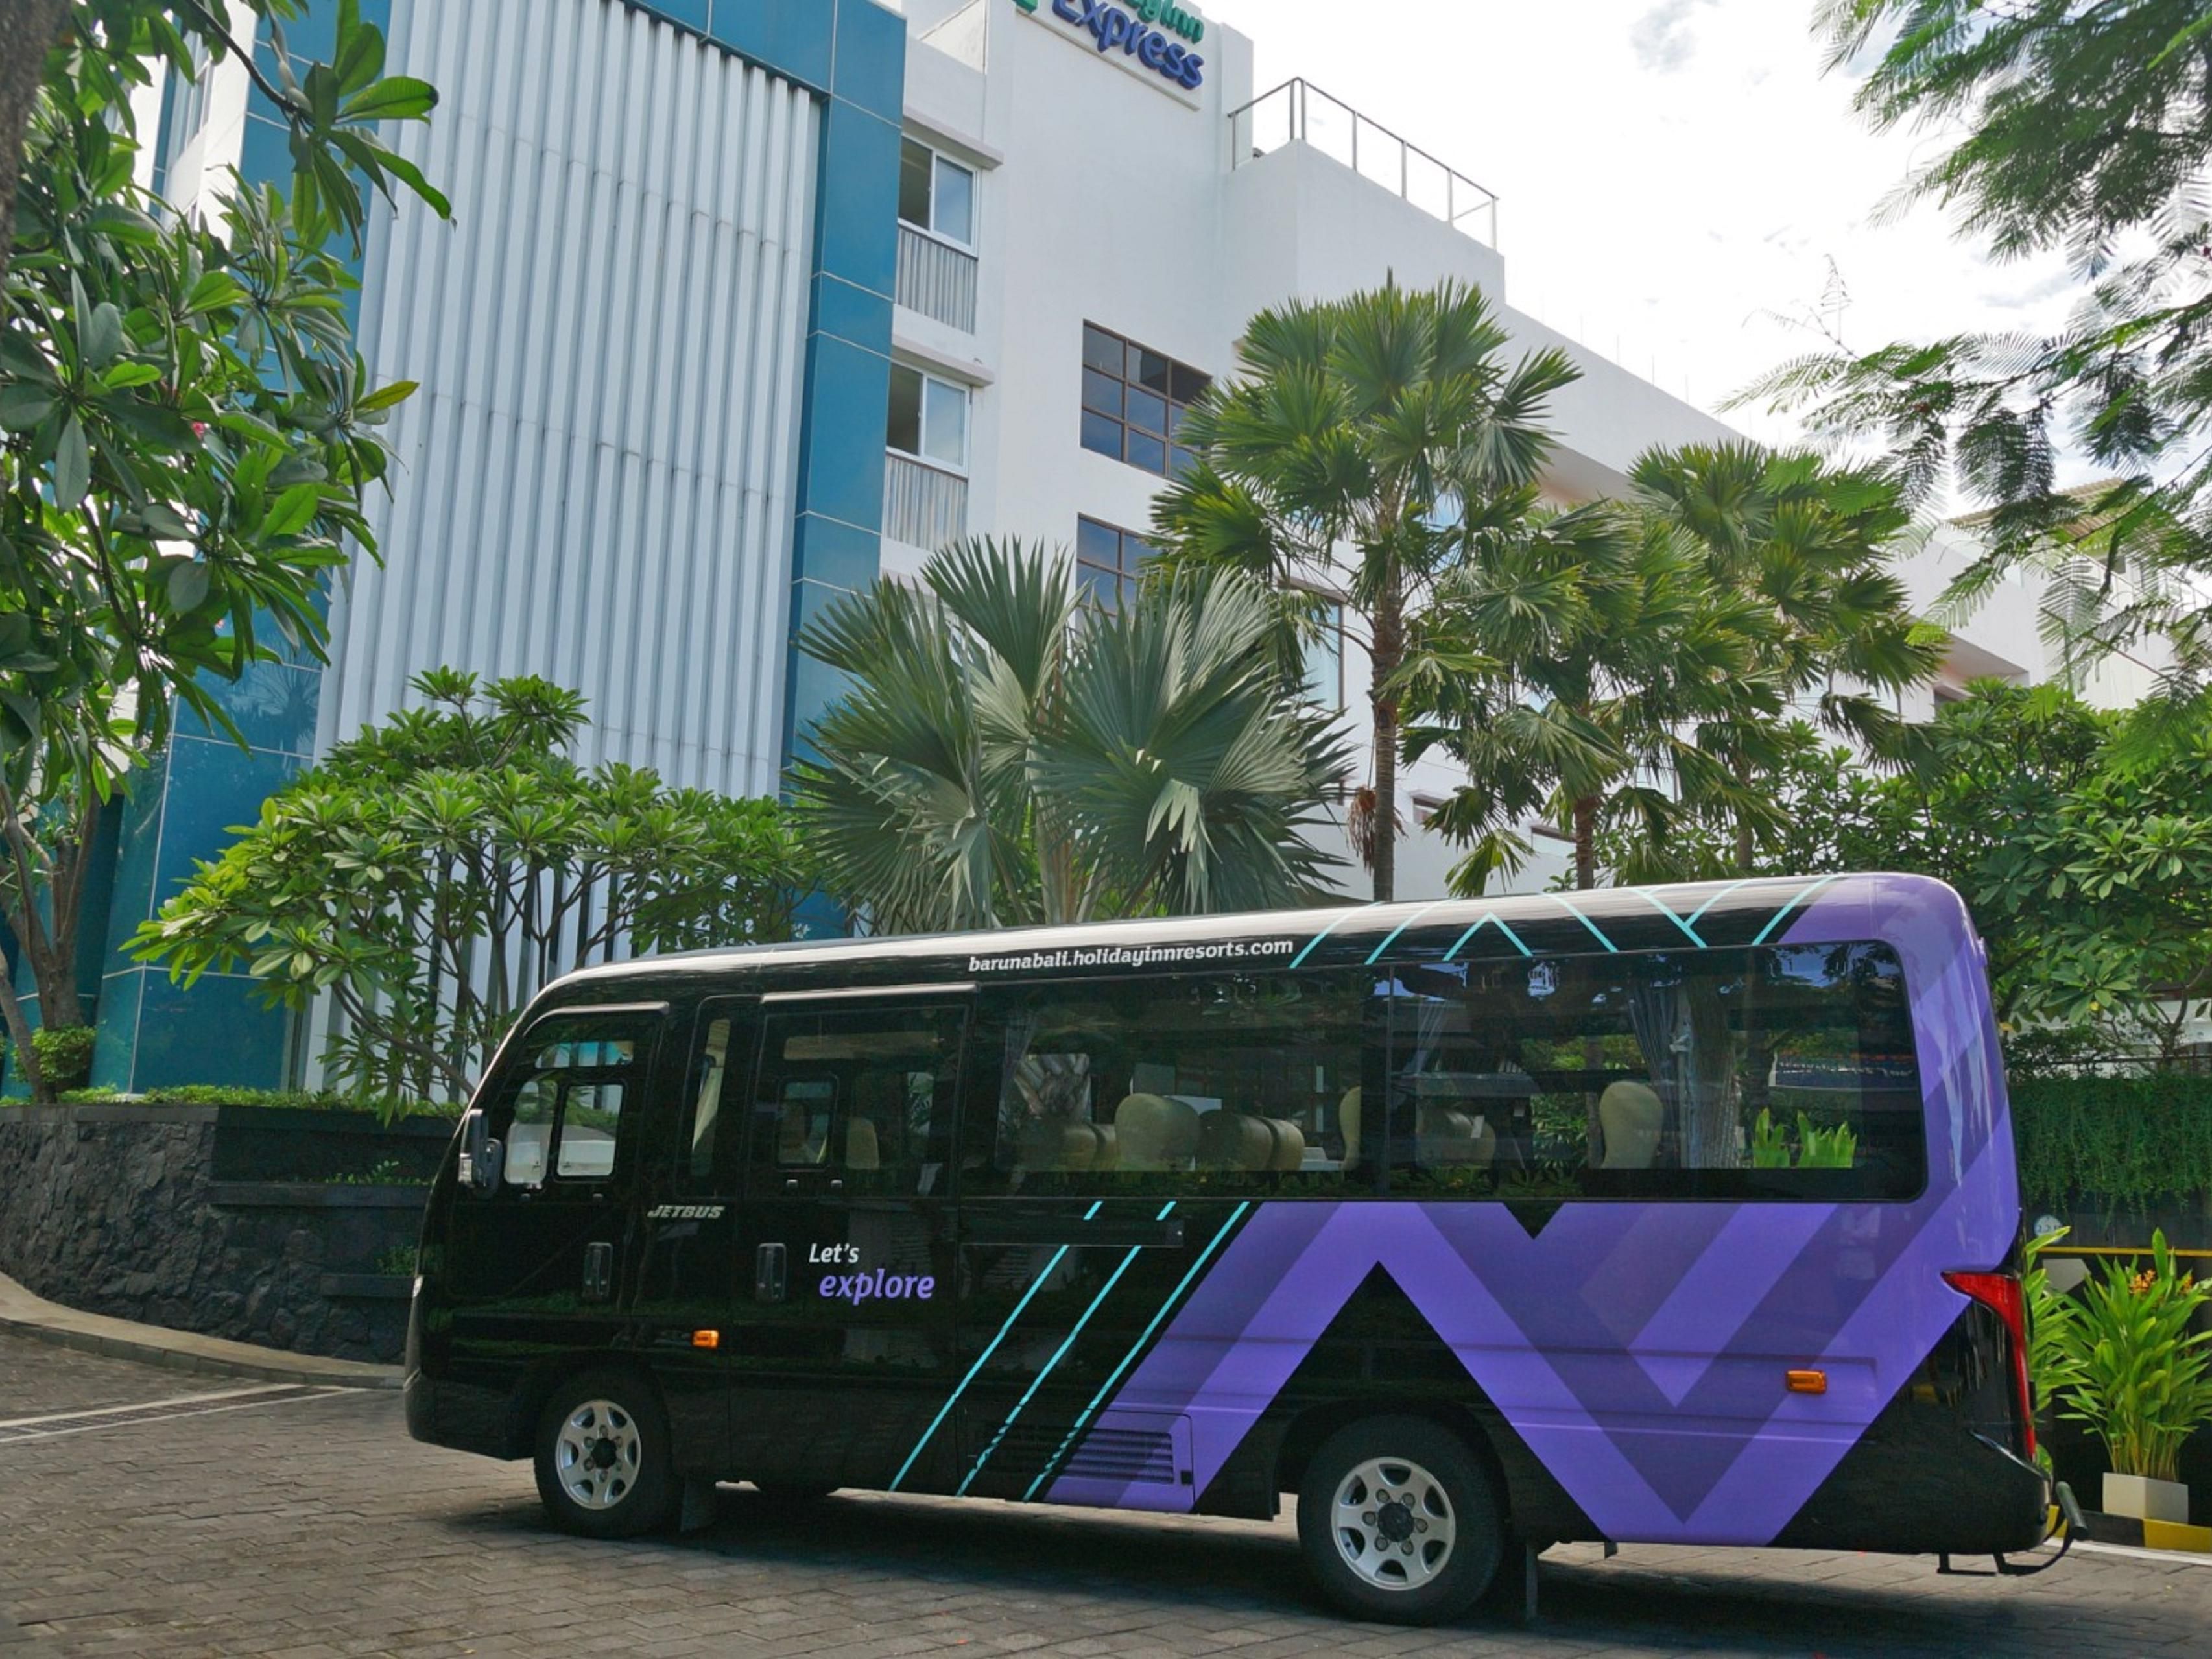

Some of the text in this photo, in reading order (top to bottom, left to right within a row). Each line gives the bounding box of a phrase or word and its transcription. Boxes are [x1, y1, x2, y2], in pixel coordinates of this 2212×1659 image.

[969, 940, 1294, 972] barunabali.holidayinnresorts.com
[647, 1205, 725, 1218] JETBUS
[809, 1243, 860, 1263] Let's
[819, 1268, 935, 1306] explore
